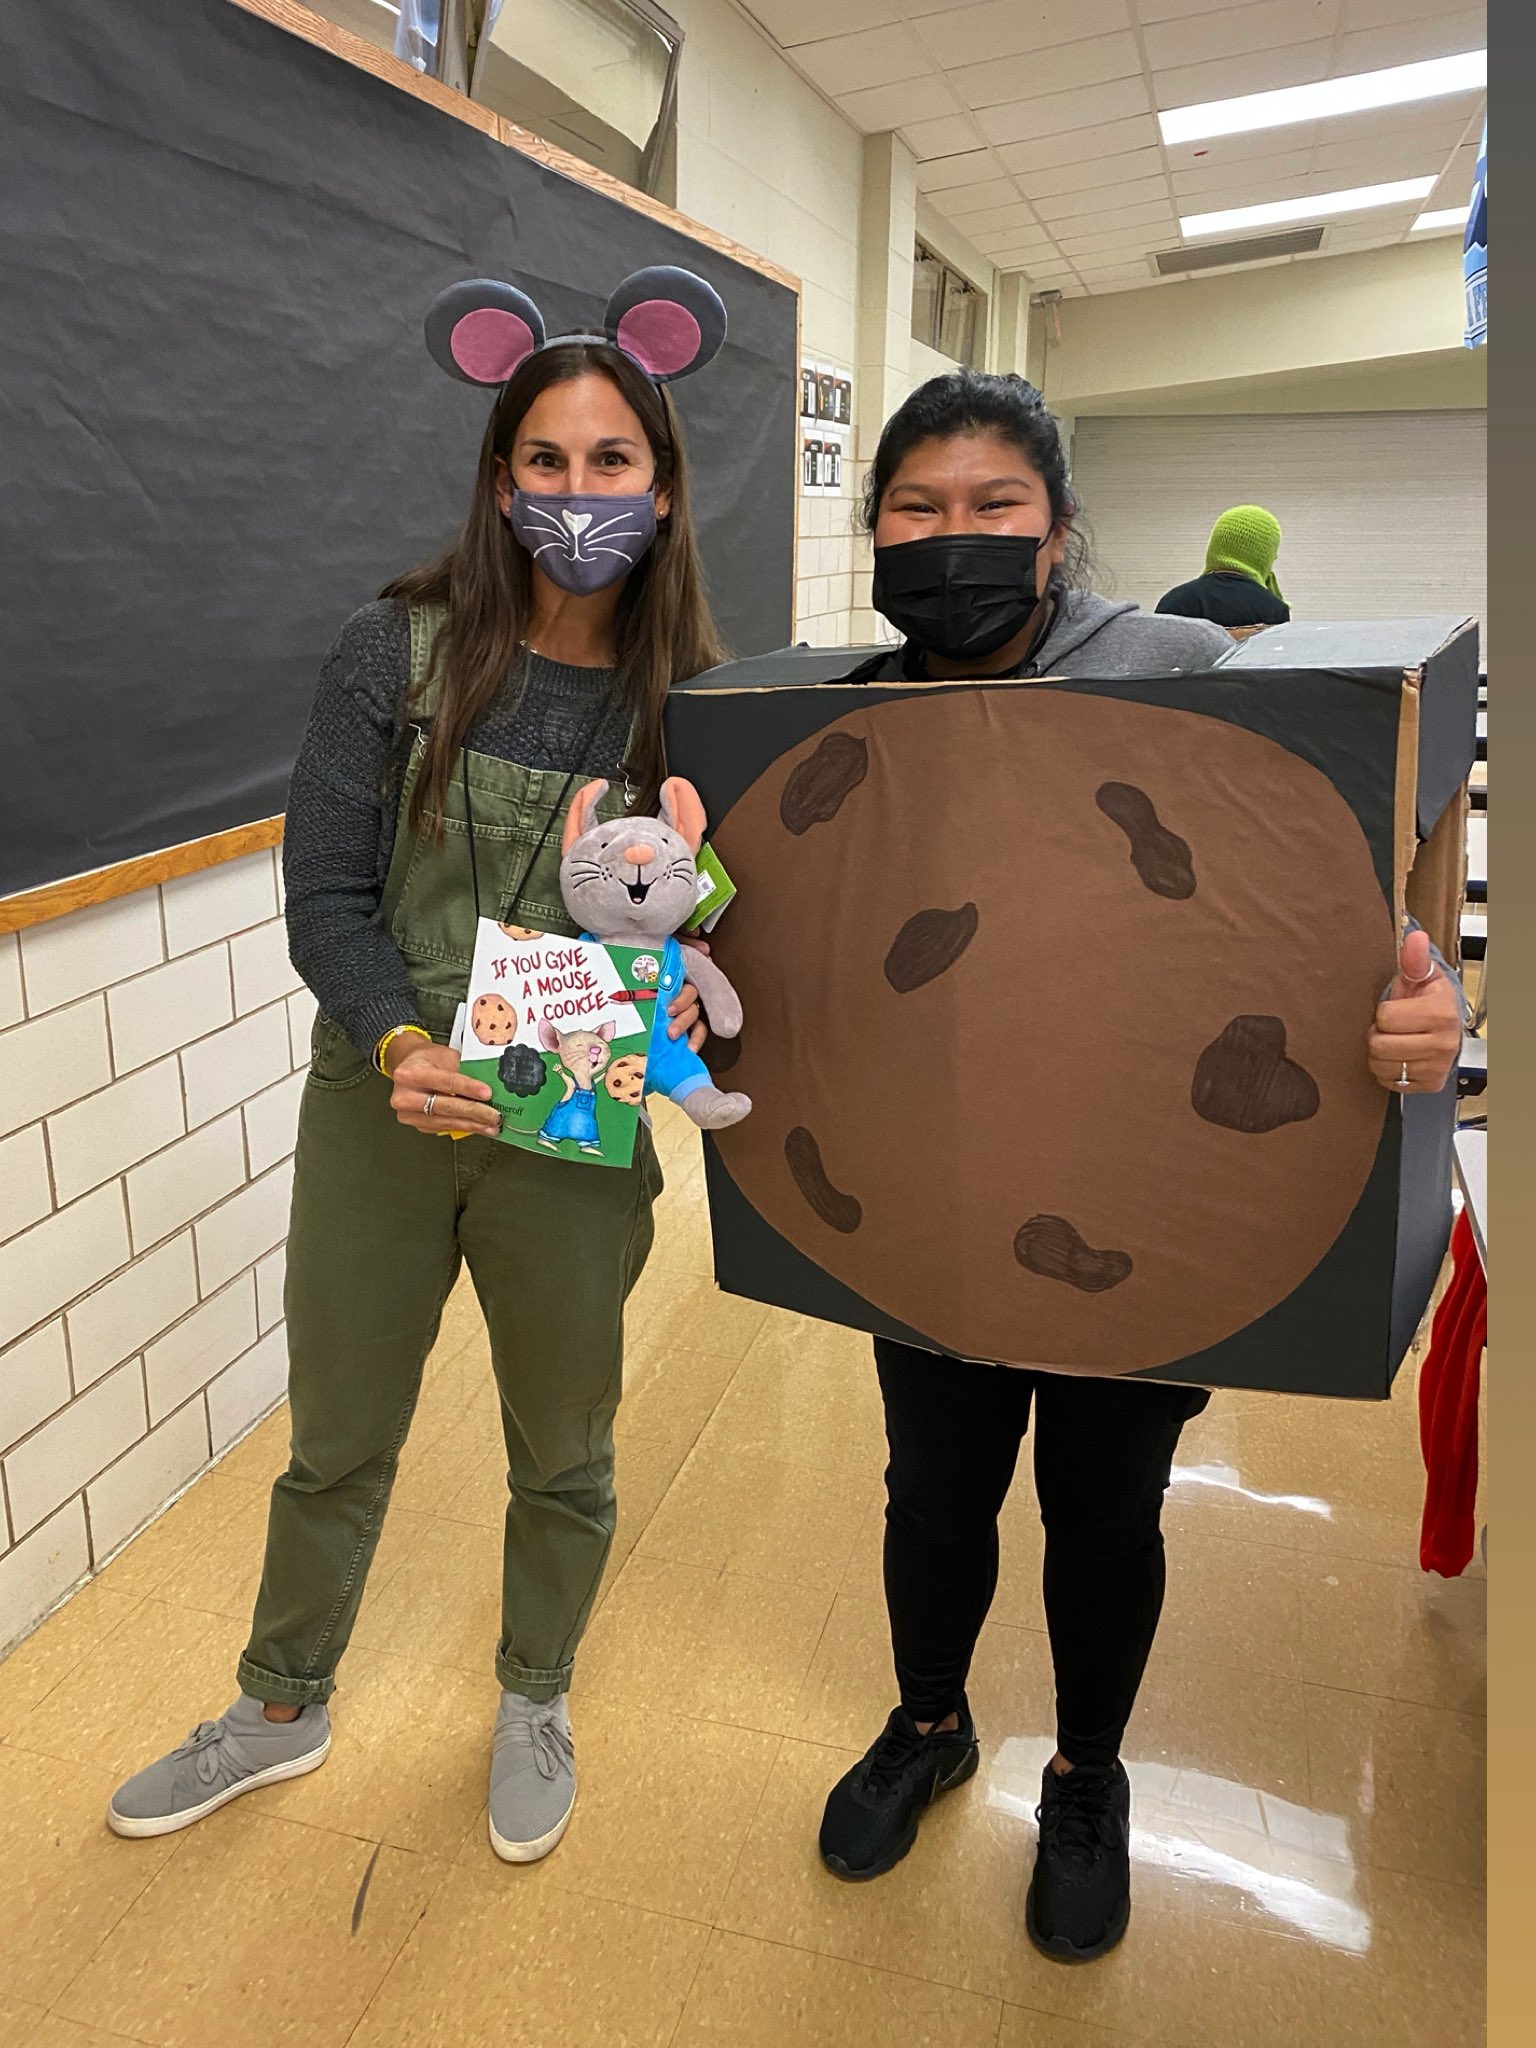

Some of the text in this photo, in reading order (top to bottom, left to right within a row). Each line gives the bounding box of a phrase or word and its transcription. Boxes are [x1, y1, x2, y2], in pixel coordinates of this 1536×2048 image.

[491, 946, 588, 980] IF YOU GIVE
[522, 970, 598, 1000] A MOUSE
[526, 990, 609, 1025] A COOKIE
